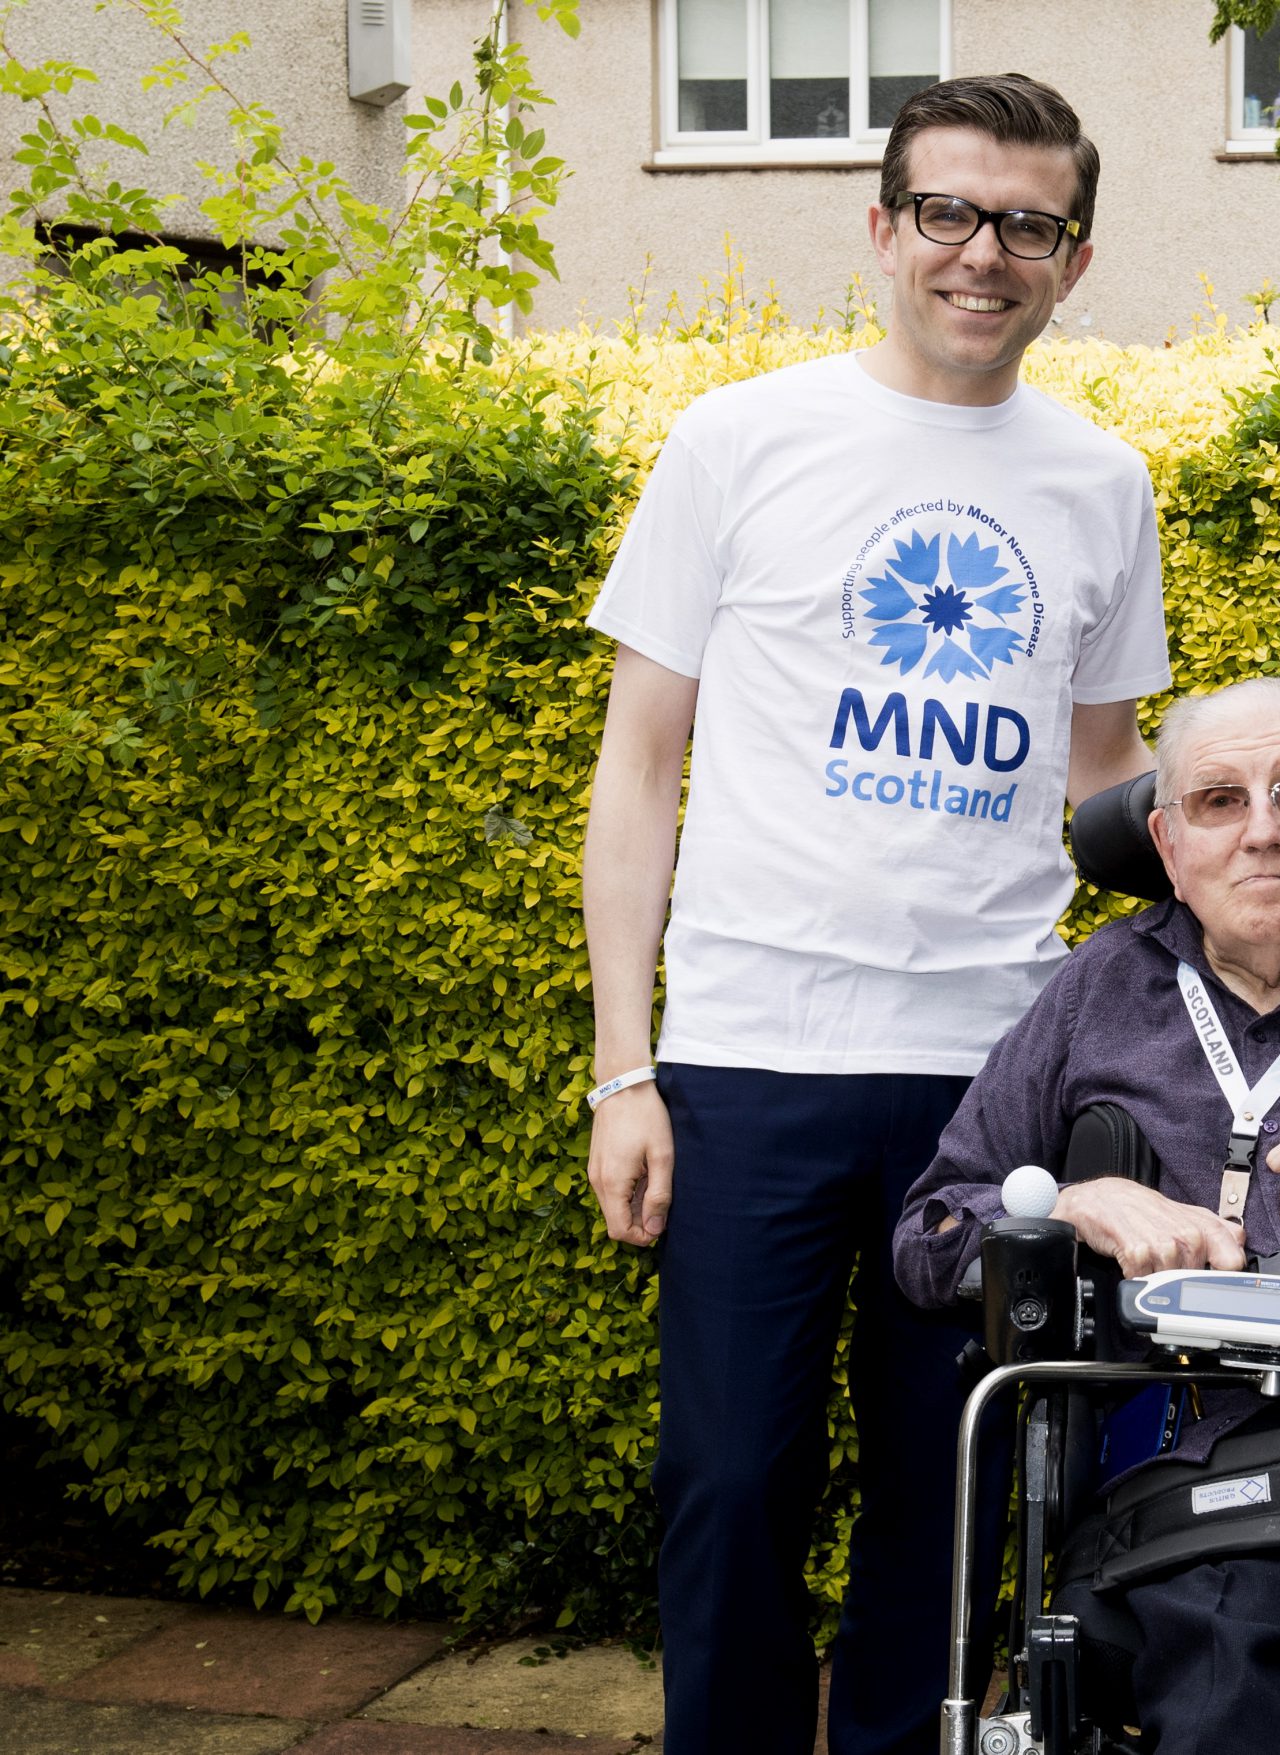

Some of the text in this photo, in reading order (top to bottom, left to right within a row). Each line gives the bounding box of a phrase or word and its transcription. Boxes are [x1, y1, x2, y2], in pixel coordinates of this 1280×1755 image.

[842, 499, 1044, 658] Supporting people affected by Motor Neurone Disease
[829, 687, 1031, 772] MND
[824, 759, 1018, 823] Scotland
[1187, 985, 1234, 1076] SCOTLAND
